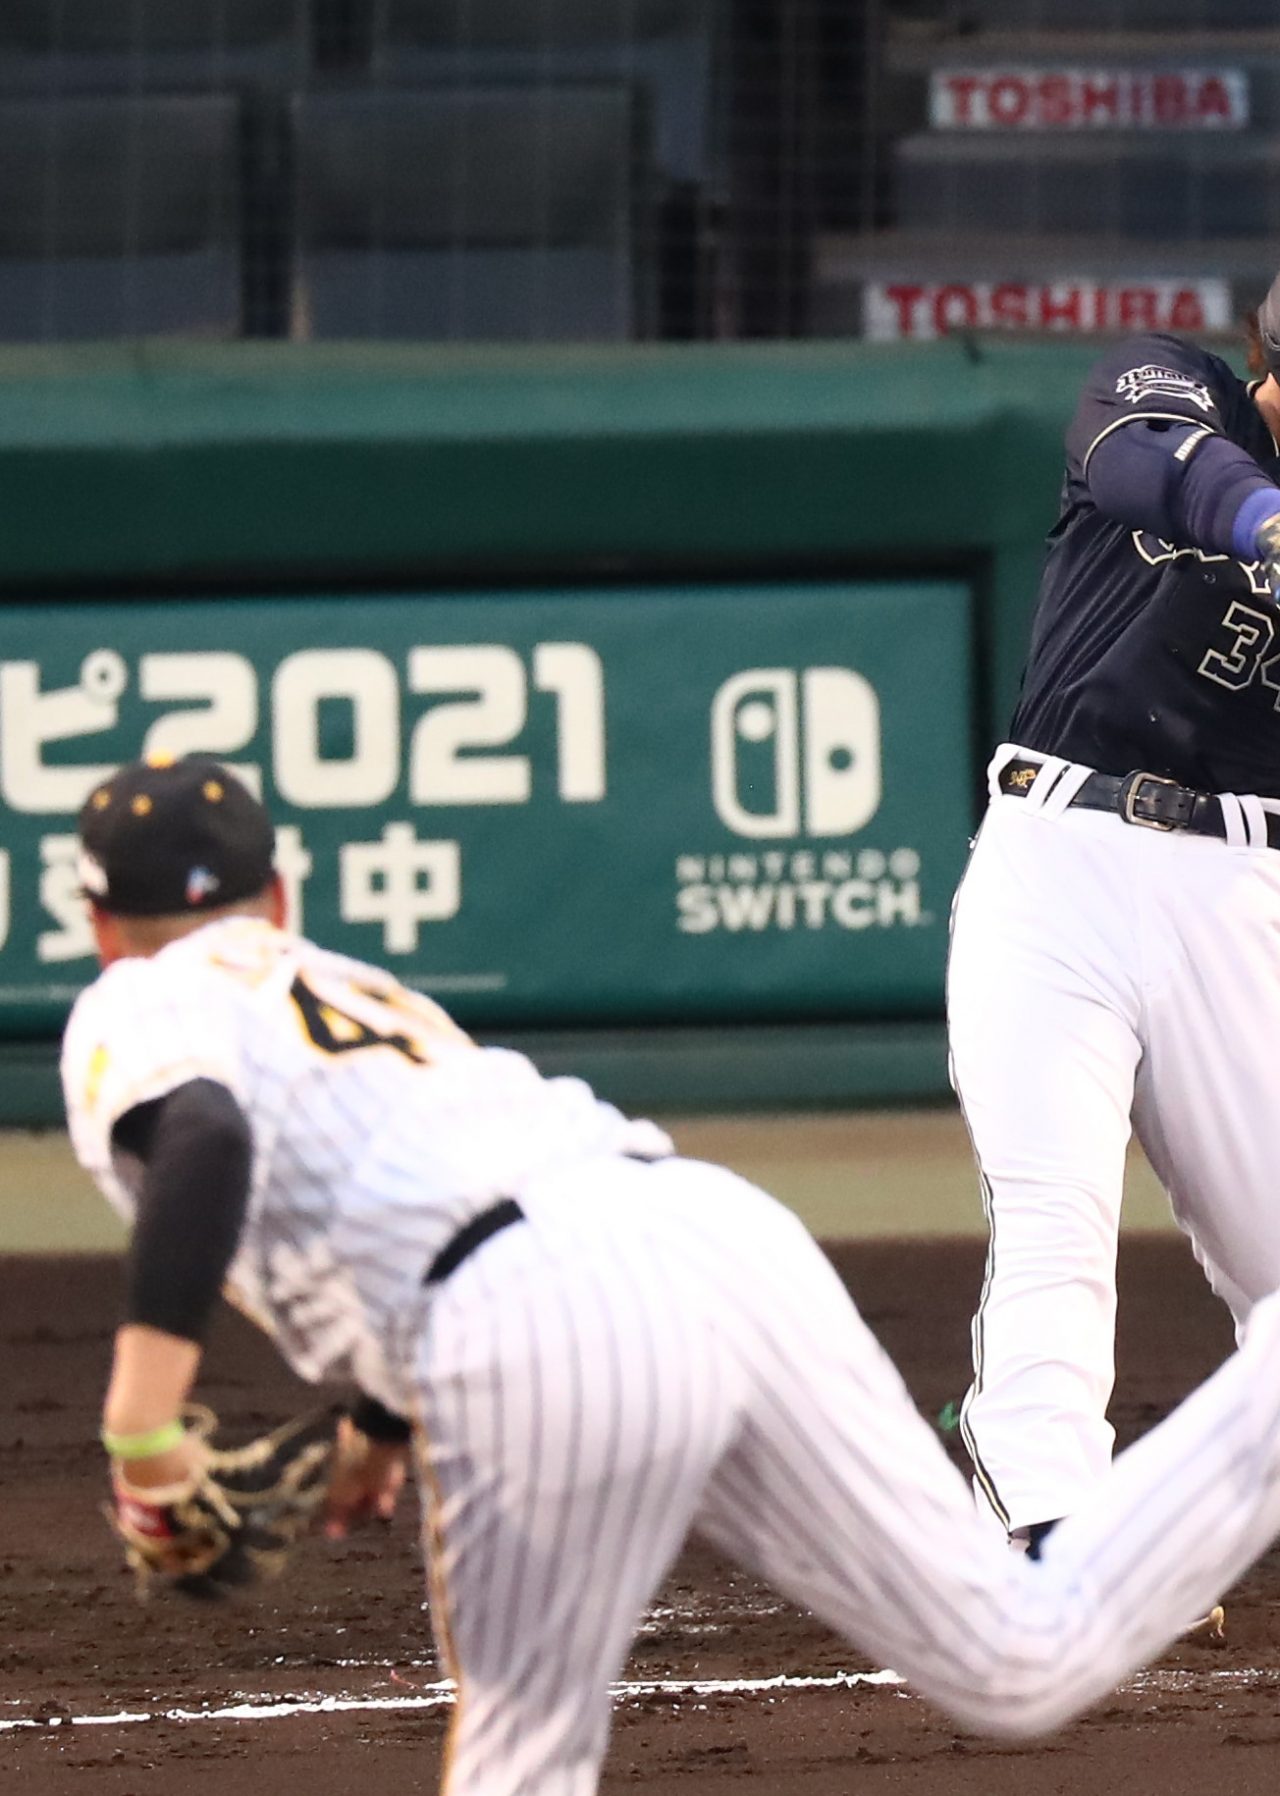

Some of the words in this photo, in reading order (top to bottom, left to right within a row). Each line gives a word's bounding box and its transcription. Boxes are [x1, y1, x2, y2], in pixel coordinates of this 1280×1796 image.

[945, 75, 1232, 123] TOSHIBA
[886, 283, 1204, 336] TOSHIBA
[676, 879, 922, 934] SWITCH
